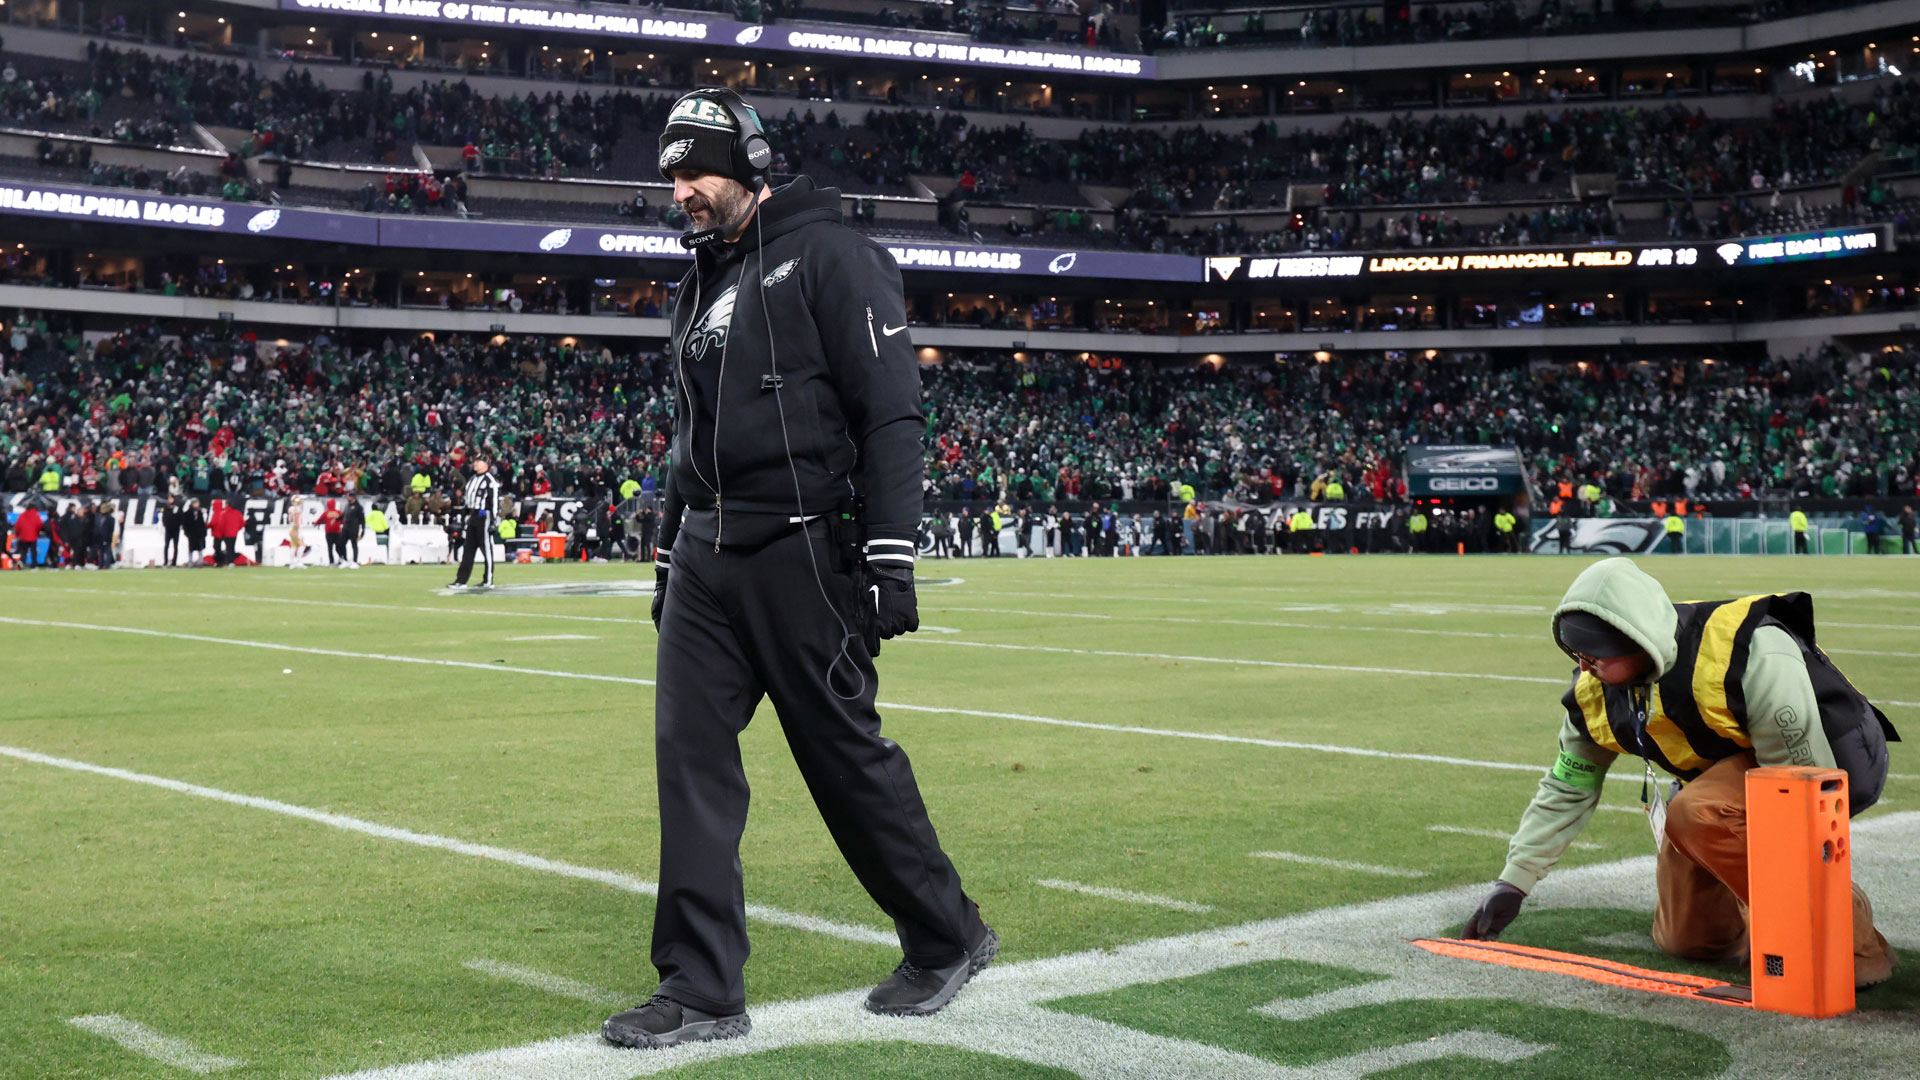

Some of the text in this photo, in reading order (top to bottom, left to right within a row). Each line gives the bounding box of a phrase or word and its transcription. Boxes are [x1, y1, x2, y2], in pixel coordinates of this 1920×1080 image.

[384, 0, 441, 18] BANK
[442, 2, 470, 20] OF
[470, 4, 507, 23] THE
[507, 7, 640, 34] PHILADELPHIA
[641, 19, 707, 39] EAGLES
[788, 31, 1141, 75] OFFICIAL BANK OF THE PHILADELPHIA EAGLES
[748, 147, 770, 160] SONY
[143, 201, 225, 227] EAGLES
[688, 233, 715, 246] SONY
[1748, 241, 1785, 259] FREE
[1785, 236, 1842, 256] EAGLES
[954, 250, 1022, 270] EAGLES
[1369, 256, 1460, 272] LINCOLN
[1461, 252, 1569, 270] FINANCIAL
[1572, 251, 1633, 267] FIELD
[1637, 248, 1674, 266] APR
[1675, 248, 1698, 265] 18
[1429, 477, 1498, 491] GEICO
[1774, 705, 1816, 767] CAR
[1571, 761, 1596, 773] CARD
